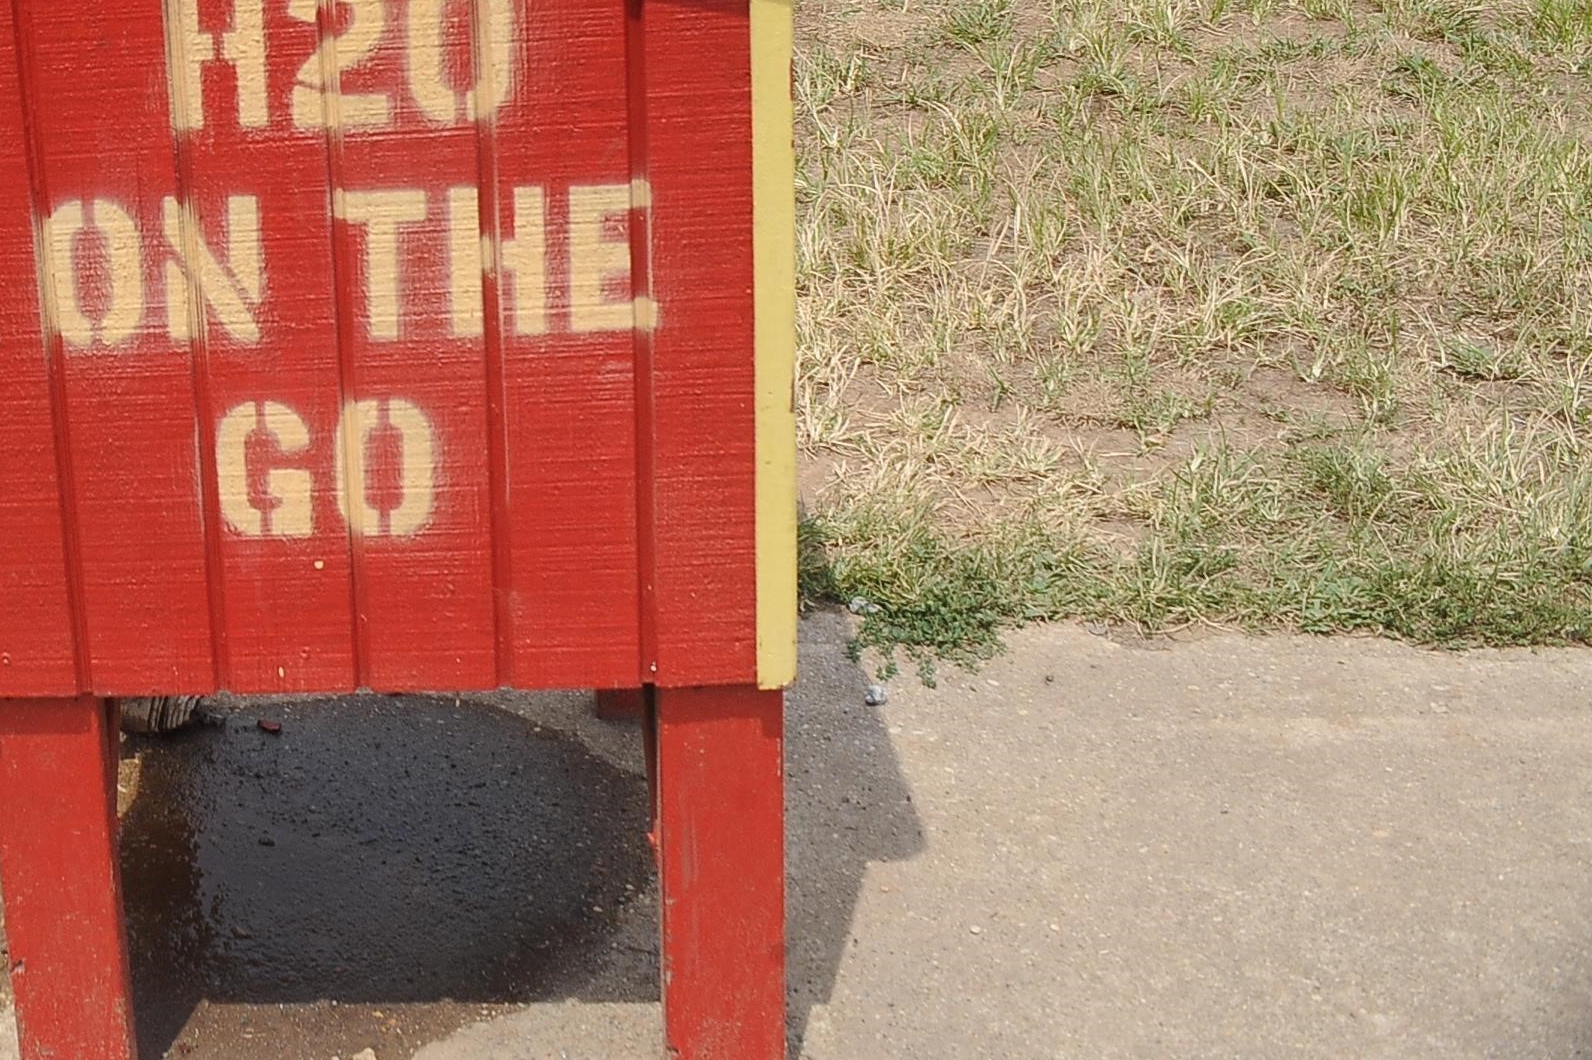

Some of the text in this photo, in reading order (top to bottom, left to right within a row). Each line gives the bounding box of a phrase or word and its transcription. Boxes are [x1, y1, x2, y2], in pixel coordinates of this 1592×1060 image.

[41, 180, 659, 345] ON THE
[215, 399, 436, 539] GO
